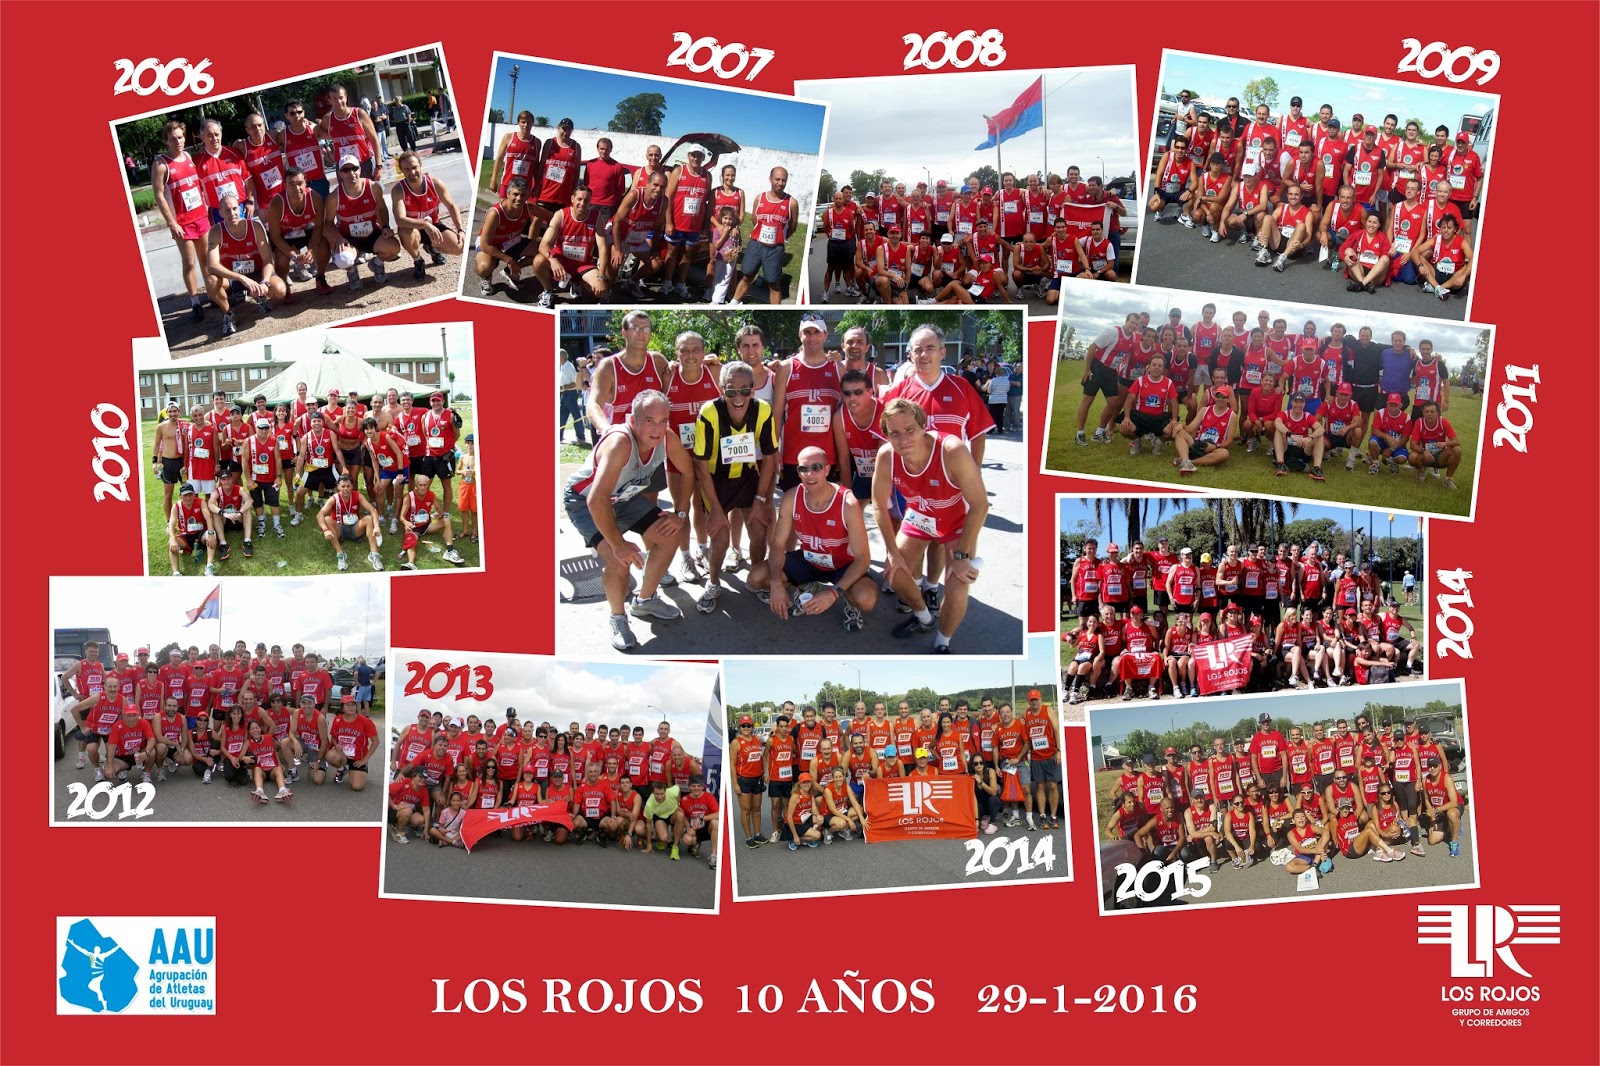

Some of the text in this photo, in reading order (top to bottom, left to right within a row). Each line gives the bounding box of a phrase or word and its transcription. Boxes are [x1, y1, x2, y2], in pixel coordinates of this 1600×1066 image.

[806, 416, 825, 425] 4002
[727, 445, 749, 456] 7000
[1207, 667, 1248, 681] LOS ROJOS
[898, 817, 914, 826] LOS
